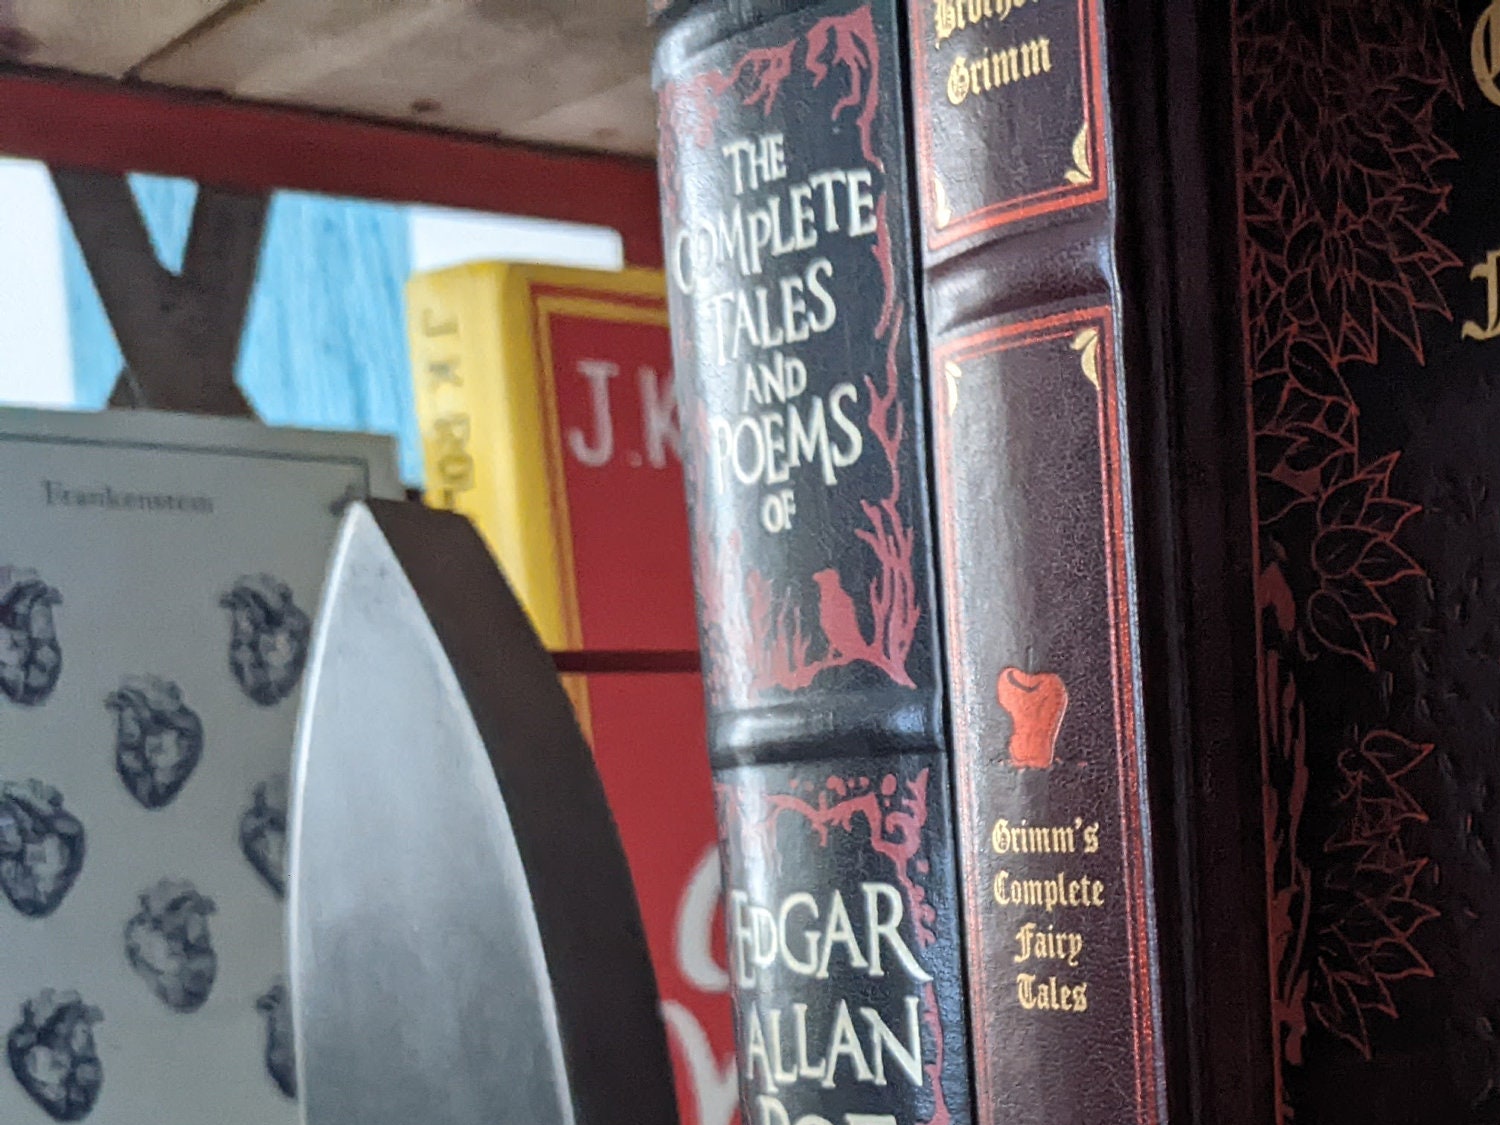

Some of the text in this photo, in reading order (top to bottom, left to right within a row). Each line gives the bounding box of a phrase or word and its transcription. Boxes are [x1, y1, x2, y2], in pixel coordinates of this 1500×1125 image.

[947, 36, 1051, 105] Grimm
[722, 132, 787, 195] THE
[673, 169, 877, 296] COMPLETE
[708, 258, 837, 367] TALES
[743, 351, 807, 412] AND
[711, 382, 863, 494] POEMS
[761, 489, 796, 533] OF
[992, 817, 1099, 854] Grimm's
[993, 870, 1105, 912] Complete
[731, 882, 934, 989] EDGAR
[1014, 922, 1083, 966] Fairy
[1016, 973, 1089, 1013] Tales
[746, 995, 924, 1094] ALLAN
